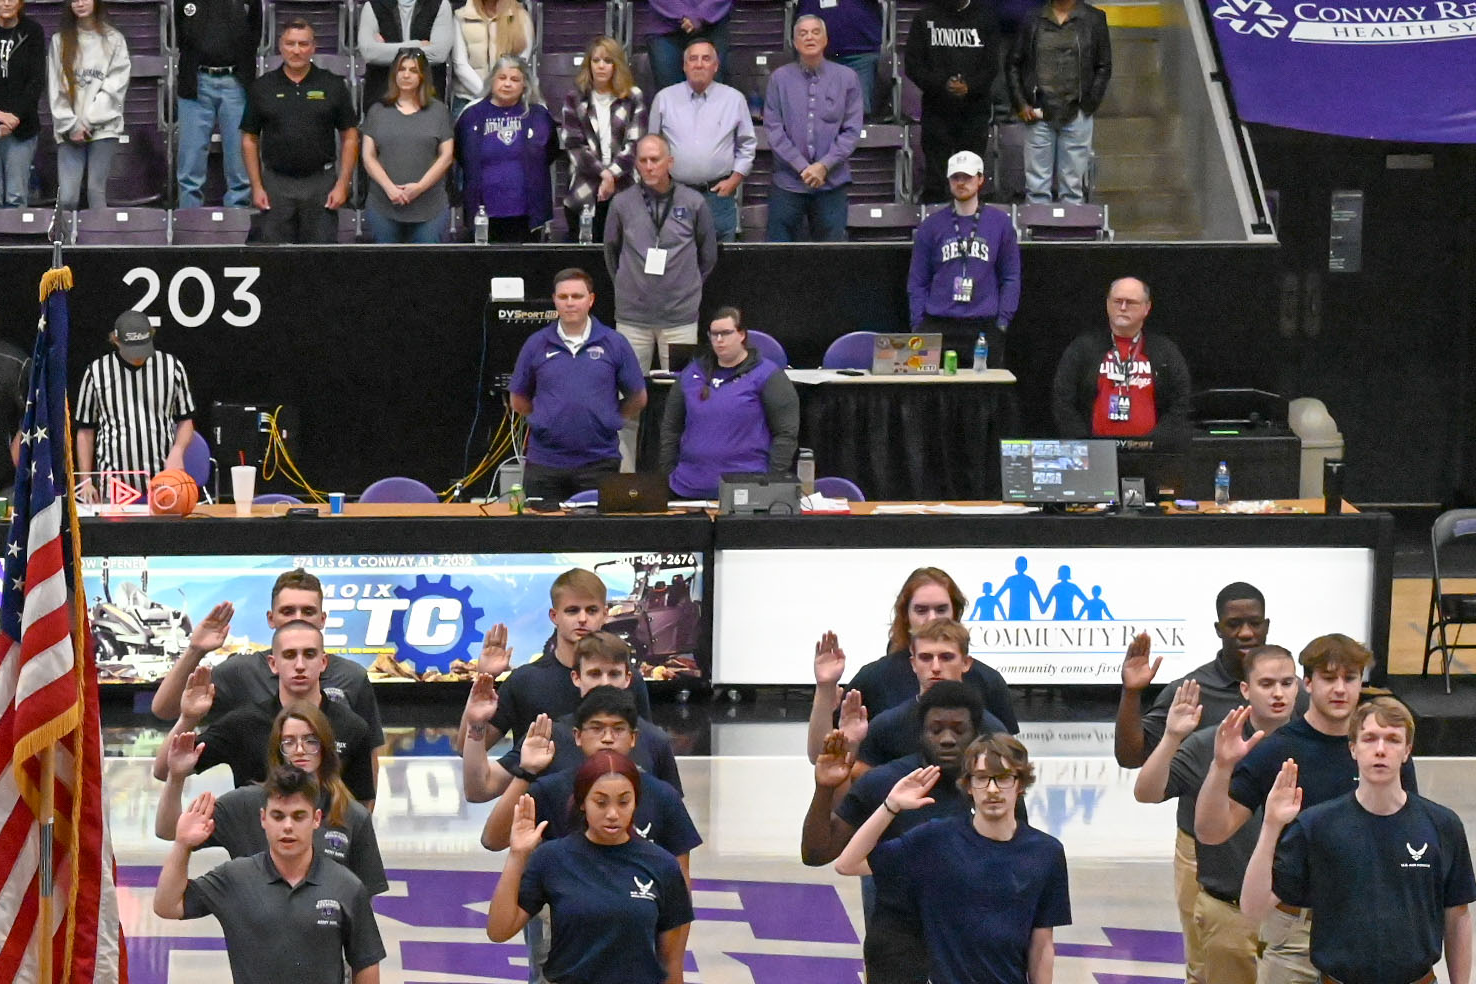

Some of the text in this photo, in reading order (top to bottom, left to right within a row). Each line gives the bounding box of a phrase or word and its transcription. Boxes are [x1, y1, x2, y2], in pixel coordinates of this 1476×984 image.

[1293, 3, 1427, 22] CONWAY
[1332, 24, 1436, 38] HEALTH
[122, 266, 262, 327] 203
[293, 557, 313, 568] 574
[323, 598, 462, 645] ETC
[968, 625, 1186, 647] COMMUNITY BNK
[996, 663, 1121, 677] community comes first
